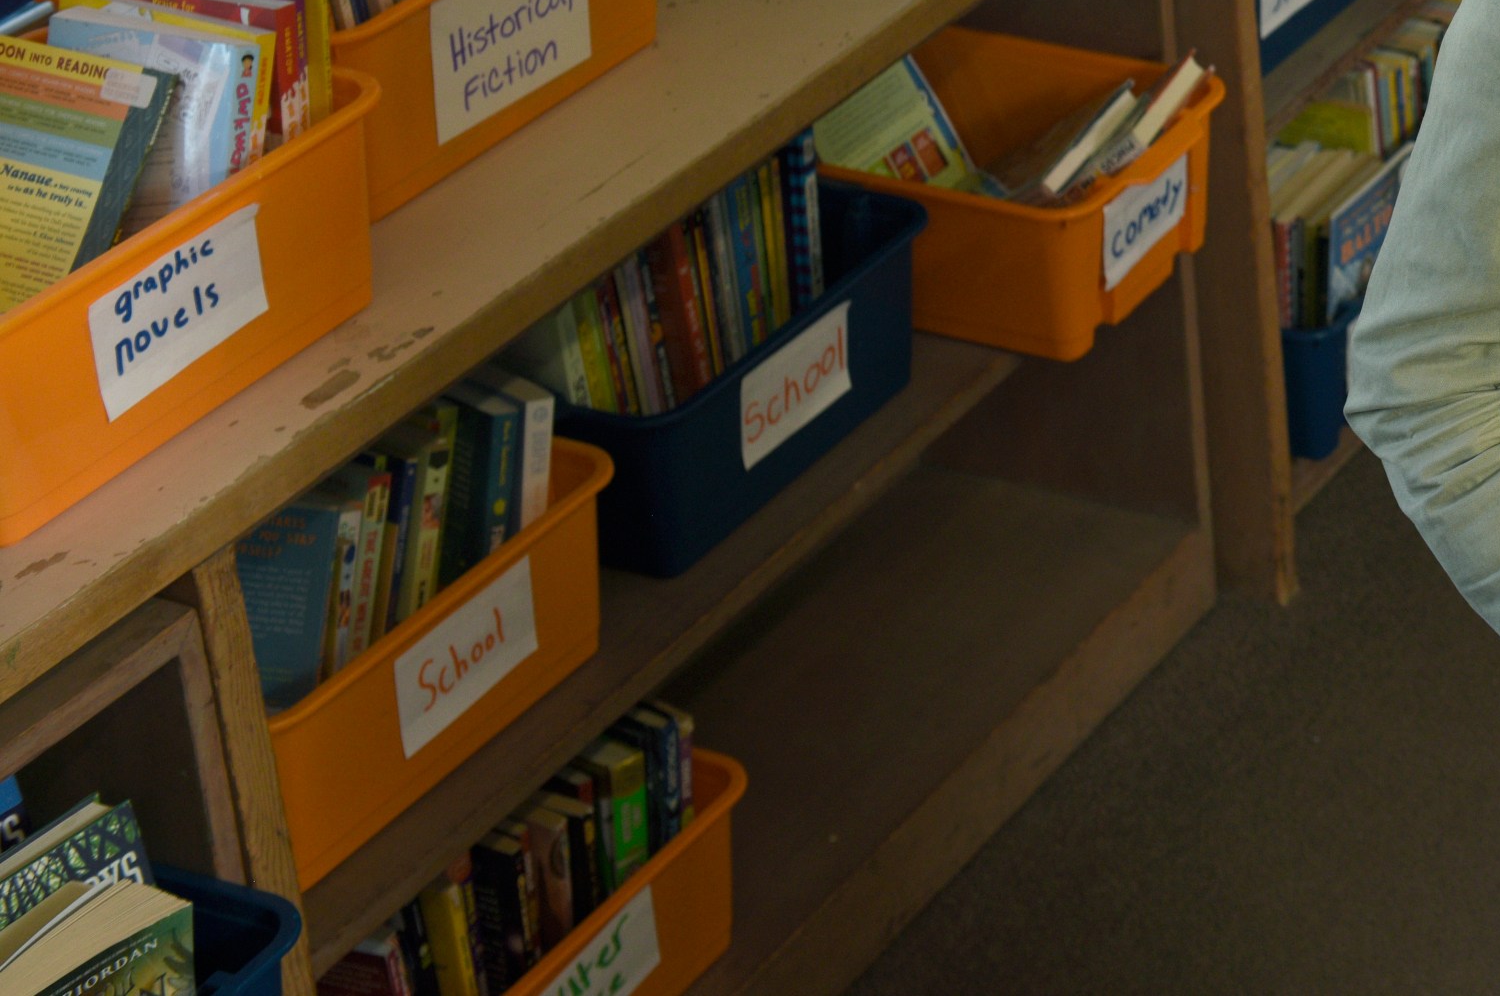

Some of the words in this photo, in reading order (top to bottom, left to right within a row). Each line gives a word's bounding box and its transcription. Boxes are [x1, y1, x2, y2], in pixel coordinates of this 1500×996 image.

[29, 51, 53, 67] INTO
[464, 40, 558, 111] Fiction
[23, 187, 34, 195] as
[35, 188, 48, 198] he
[49, 192, 73, 207] truly
[114, 237, 214, 323] graphic
[115, 281, 220, 376] novels
[744, 325, 845, 445] School
[416, 605, 506, 712] School
